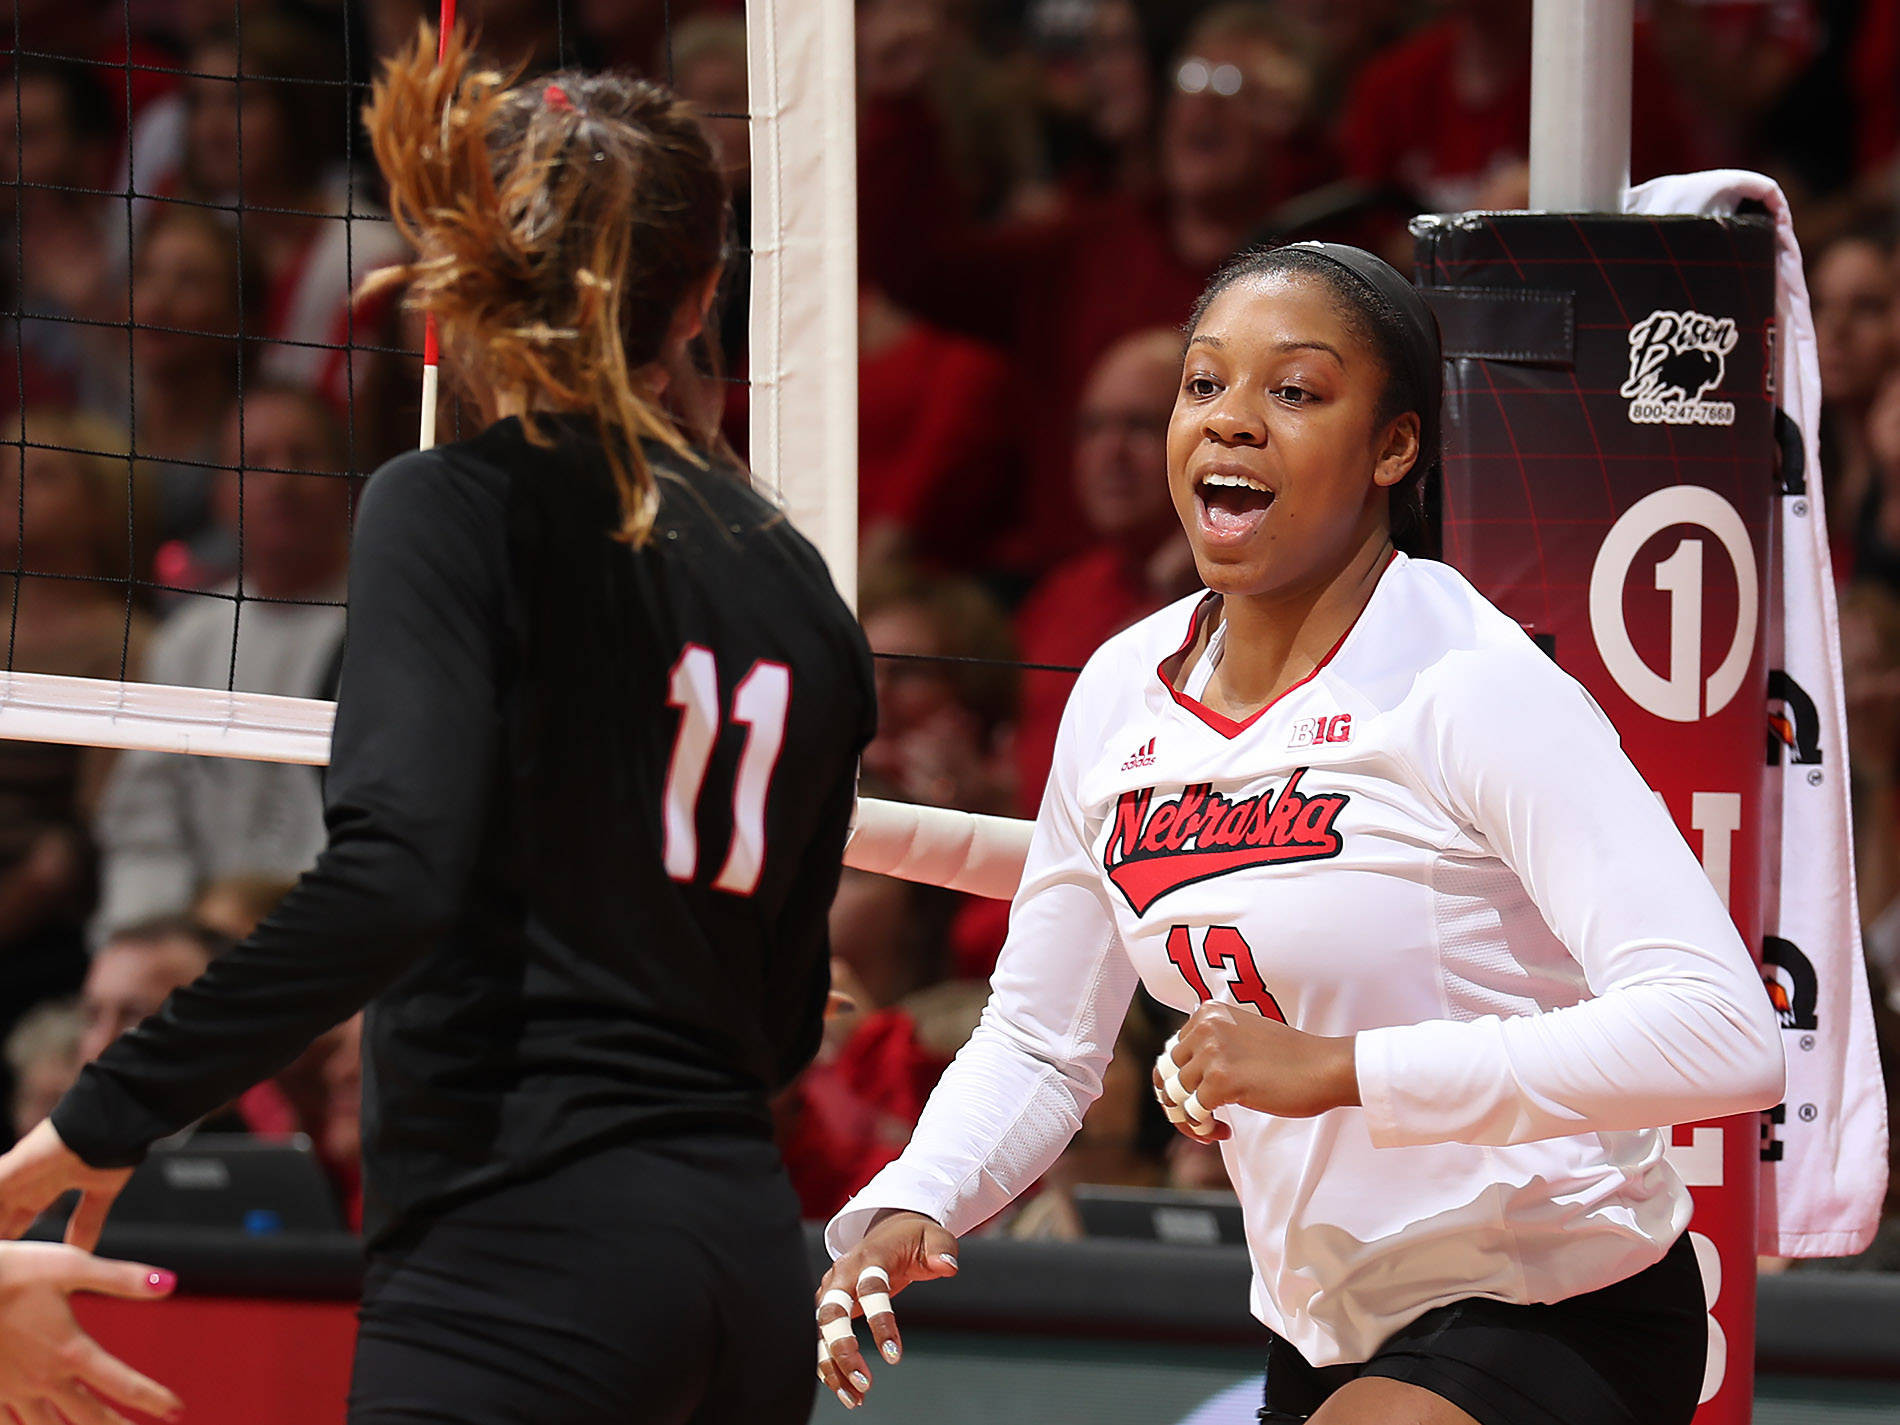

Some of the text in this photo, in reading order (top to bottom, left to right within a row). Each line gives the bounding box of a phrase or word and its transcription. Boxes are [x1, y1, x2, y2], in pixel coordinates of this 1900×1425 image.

[663, 641, 794, 898] 11
[1120, 756, 1157, 772] adidas
[1104, 766, 1350, 870] Nebraska
[1165, 924, 1289, 1026] 13
